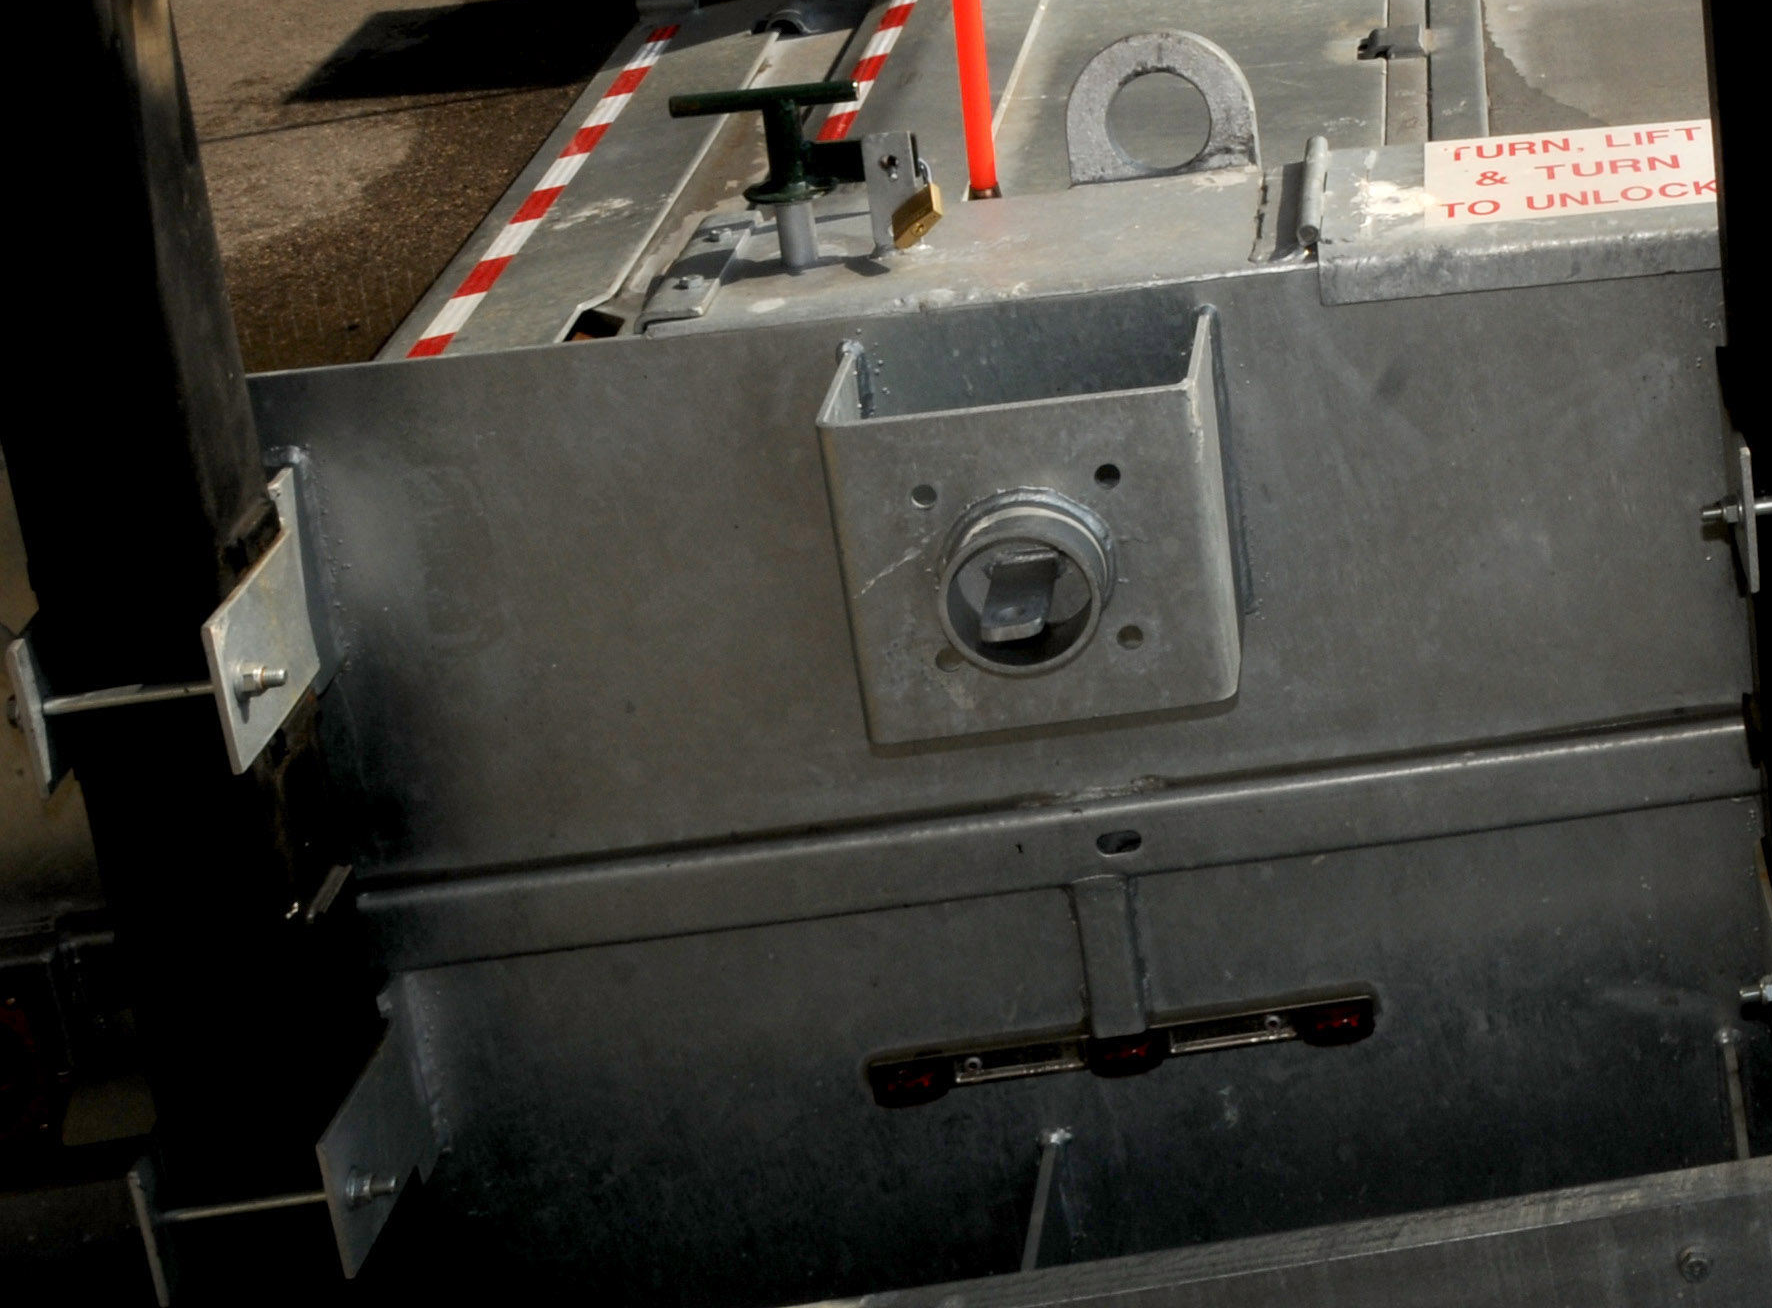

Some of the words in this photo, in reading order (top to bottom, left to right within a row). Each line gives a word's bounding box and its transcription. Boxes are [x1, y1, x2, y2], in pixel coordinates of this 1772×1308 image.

[1605, 126, 1702, 149] LIFT
[1475, 171, 1509, 187] &
[1534, 154, 1681, 180] TURN
[1440, 199, 1501, 218] TO
[1526, 179, 1719, 210] UNLOCK
